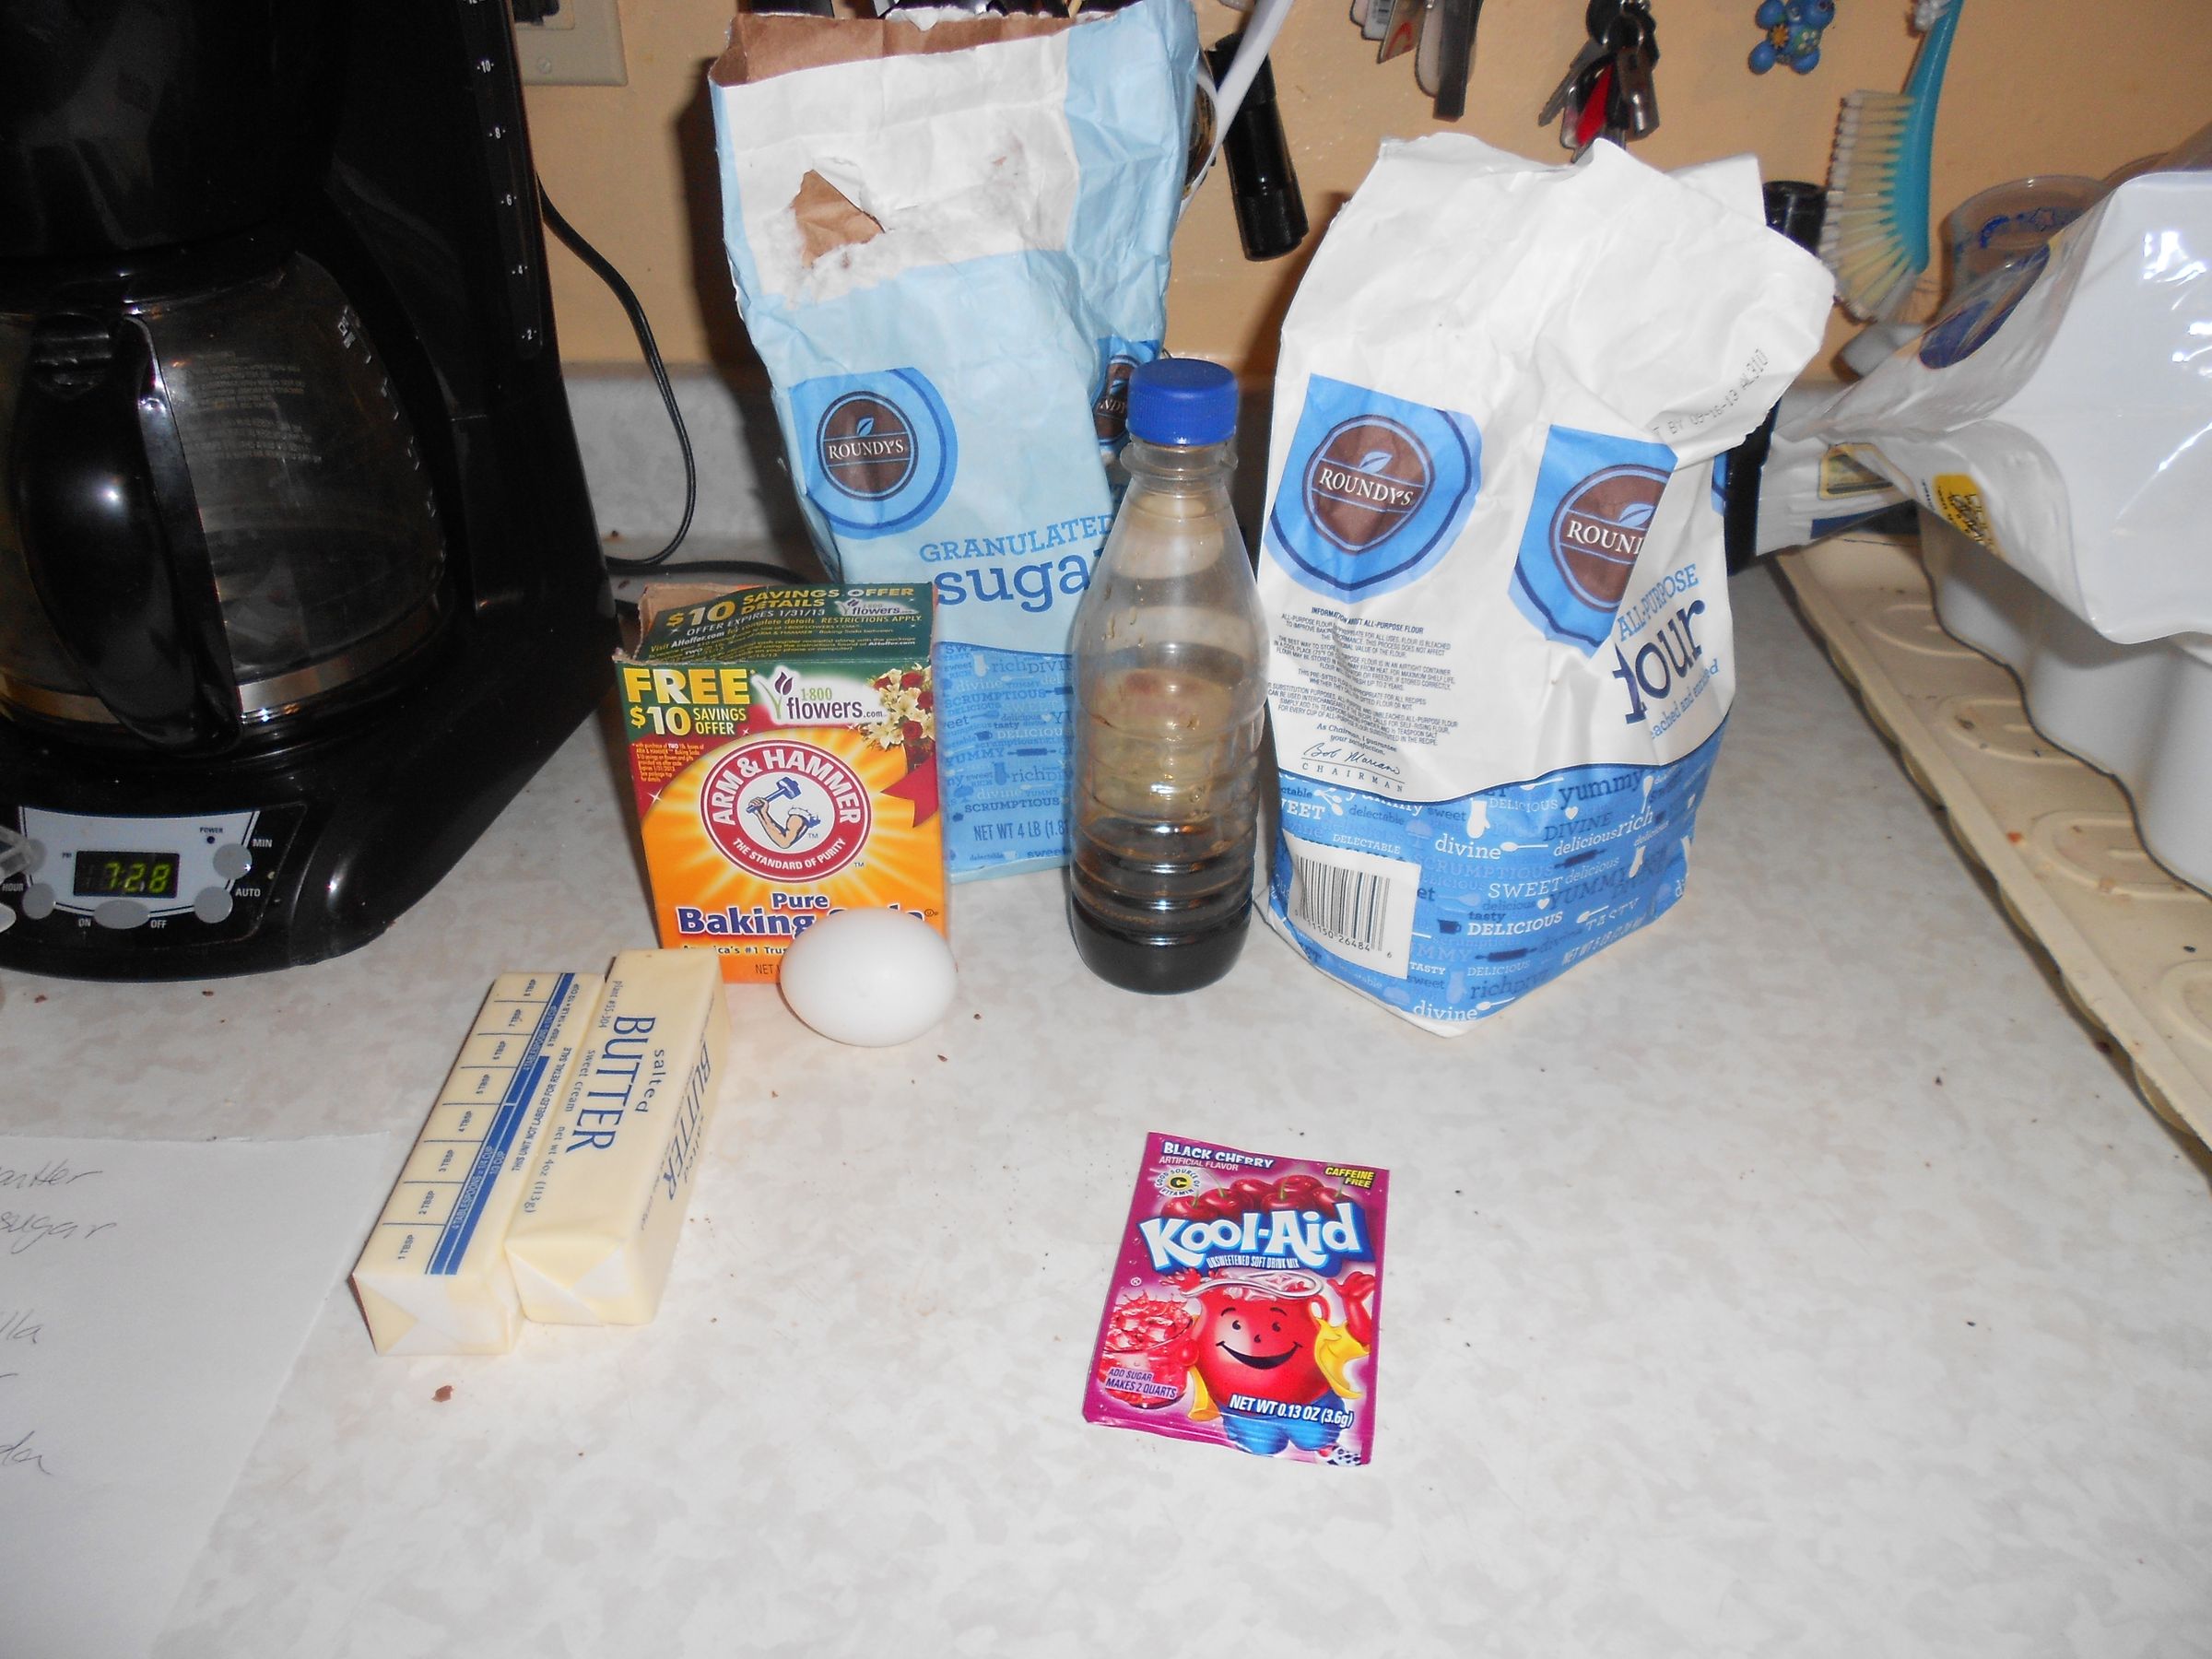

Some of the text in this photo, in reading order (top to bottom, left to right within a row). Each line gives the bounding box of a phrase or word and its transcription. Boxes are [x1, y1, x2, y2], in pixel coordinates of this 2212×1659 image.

[481, 60, 491, 73] 10
[495, 127, 501, 138] 8
[506, 194, 512, 206] 6
[828, 437, 904, 461] ROUNDY'S
[1317, 465, 1415, 508] ROUNDY'S
[1566, 519, 1644, 557] ROUN
[934, 549, 1107, 613] suga
[665, 587, 914, 628] $10 SAVINGS OFFER
[741, 599, 825, 615] DETAILS
[687, 608, 826, 637] OFFER EXPIRES 1/31/13
[821, 616, 889, 624] RESTRICTIONS
[1364, 619, 1403, 632] ALL-PURPOSE
[1405, 625, 1424, 634] FLOUR
[630, 706, 691, 735] $10
[693, 707, 747, 723] SAVINGS
[695, 722, 735, 735] OFFER
[994, 721, 1020, 730] tasty
[1317, 723, 1327, 731] As
[1330, 735, 1347, 743] your
[1011, 765, 1045, 782] rich
[711, 770, 741, 826] ARM
[739, 756, 763, 778] &
[761, 748, 862, 824] HAMMER
[1559, 768, 1646, 810] yummy
[964, 797, 1060, 813] SCRUMPTIOUS
[1428, 806, 1467, 822] sweet
[1488, 797, 1559, 813] DELICIOUS
[1348, 805, 1406, 825] delectable
[973, 824, 994, 841] NET
[996, 823, 1014, 839] WT
[1018, 822, 1025, 839] 4
[1028, 820, 1041, 837] LB
[1543, 811, 1613, 842] DIVINE
[253, 837, 273, 849] MIN
[1333, 833, 1402, 855] DELECTABLE
[1435, 833, 1502, 860] divine
[733, 837, 847, 871] THE STANDARD OF PURITY
[235, 887, 261, 899] AUTO
[1488, 876, 1564, 899] SWEET
[771, 892, 830, 910] Pure
[78, 918, 92, 928] ON
[150, 919, 168, 930] OFF
[677, 906, 817, 939] Baking
[1467, 911, 1507, 924] tasty
[1467, 911, 1564, 936] DELICIOUS
[1338, 935, 1371, 952] 26484
[755, 964, 774, 975] NET
[1409, 961, 1446, 975] TASTY
[1470, 975, 1514, 1000] rich
[1413, 1000, 1478, 1022] divine
[565, 1049, 596, 1112] sweet cream
[565, 1016, 656, 1154] BUTTER
[635, 1049, 667, 1112] salted
[512, 1047, 572, 1171] THIS UNIT NOT LABELED FOR RETAIL SALE
[663, 1041, 712, 1200] BUTTER
[554, 1125, 566, 1141] net
[493, 1151, 506, 1164] CUP
[1159, 1155, 1239, 1171] ARTIFICIAL FLAVOR
[1163, 1141, 1274, 1169] BLACK CHERRY
[540, 1159, 554, 1177] 4oz
[1324, 1167, 1375, 1181] CAFFEINE
[1155, 1171, 1170, 1187] GOOD
[1170, 1168, 1198, 1181] SOURCE
[1344, 1177, 1372, 1189] FREE
[524, 1181, 547, 1214] (113g)
[1161, 1187, 1194, 1196] VITAMIN
[1139, 1202, 1361, 1269] Kool-Aid
[1206, 1254, 1300, 1269] UNSWEETENED SOFT DRINK MIX
[1108, 1368, 1153, 1382] ADD SUGAR
[1106, 1378, 1177, 1399] MAKES 2 QUARTS
[1229, 1394, 1354, 1430] NET WT 0.13 OZ (3.6g)
